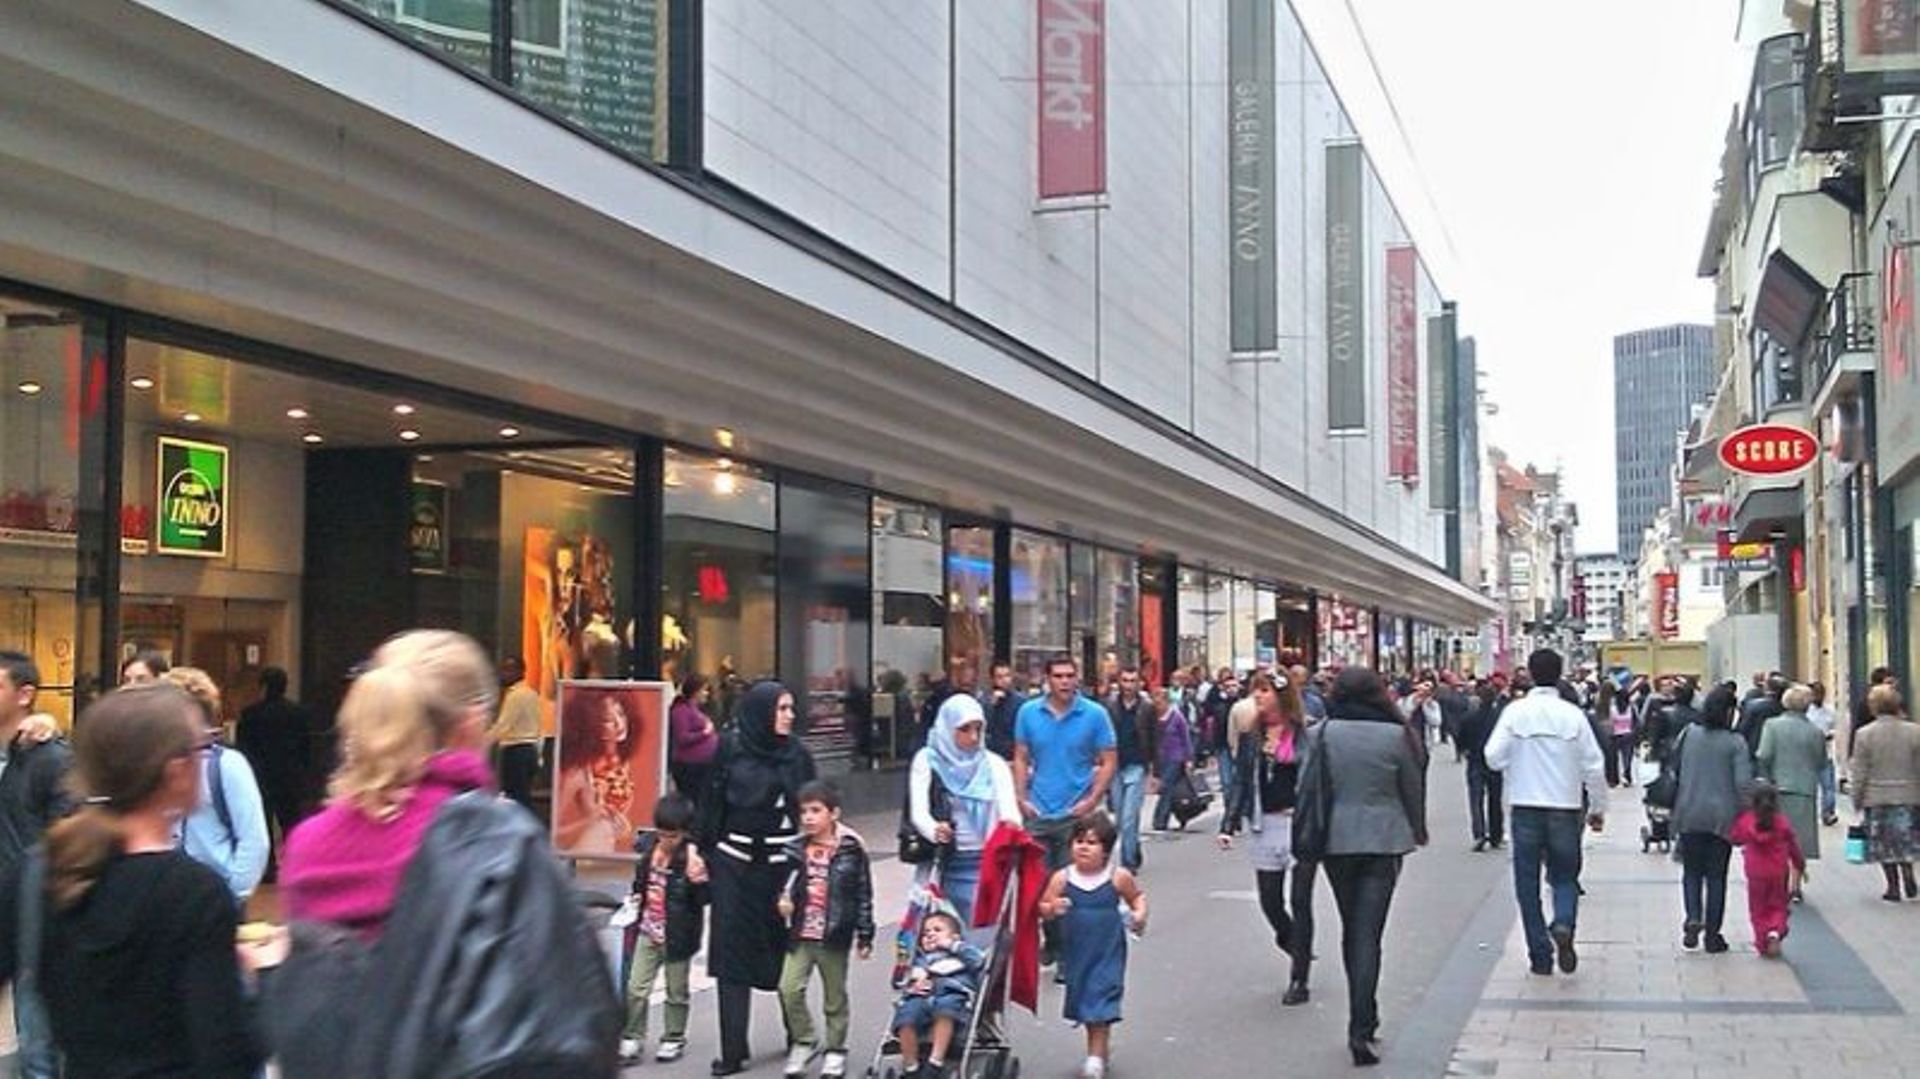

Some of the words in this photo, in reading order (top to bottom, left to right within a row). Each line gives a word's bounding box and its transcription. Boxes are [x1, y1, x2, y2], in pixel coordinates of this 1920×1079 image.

[1235, 184, 1262, 262] INNO
[1736, 440, 1804, 461] SCORE
[169, 497, 220, 527] INNO
